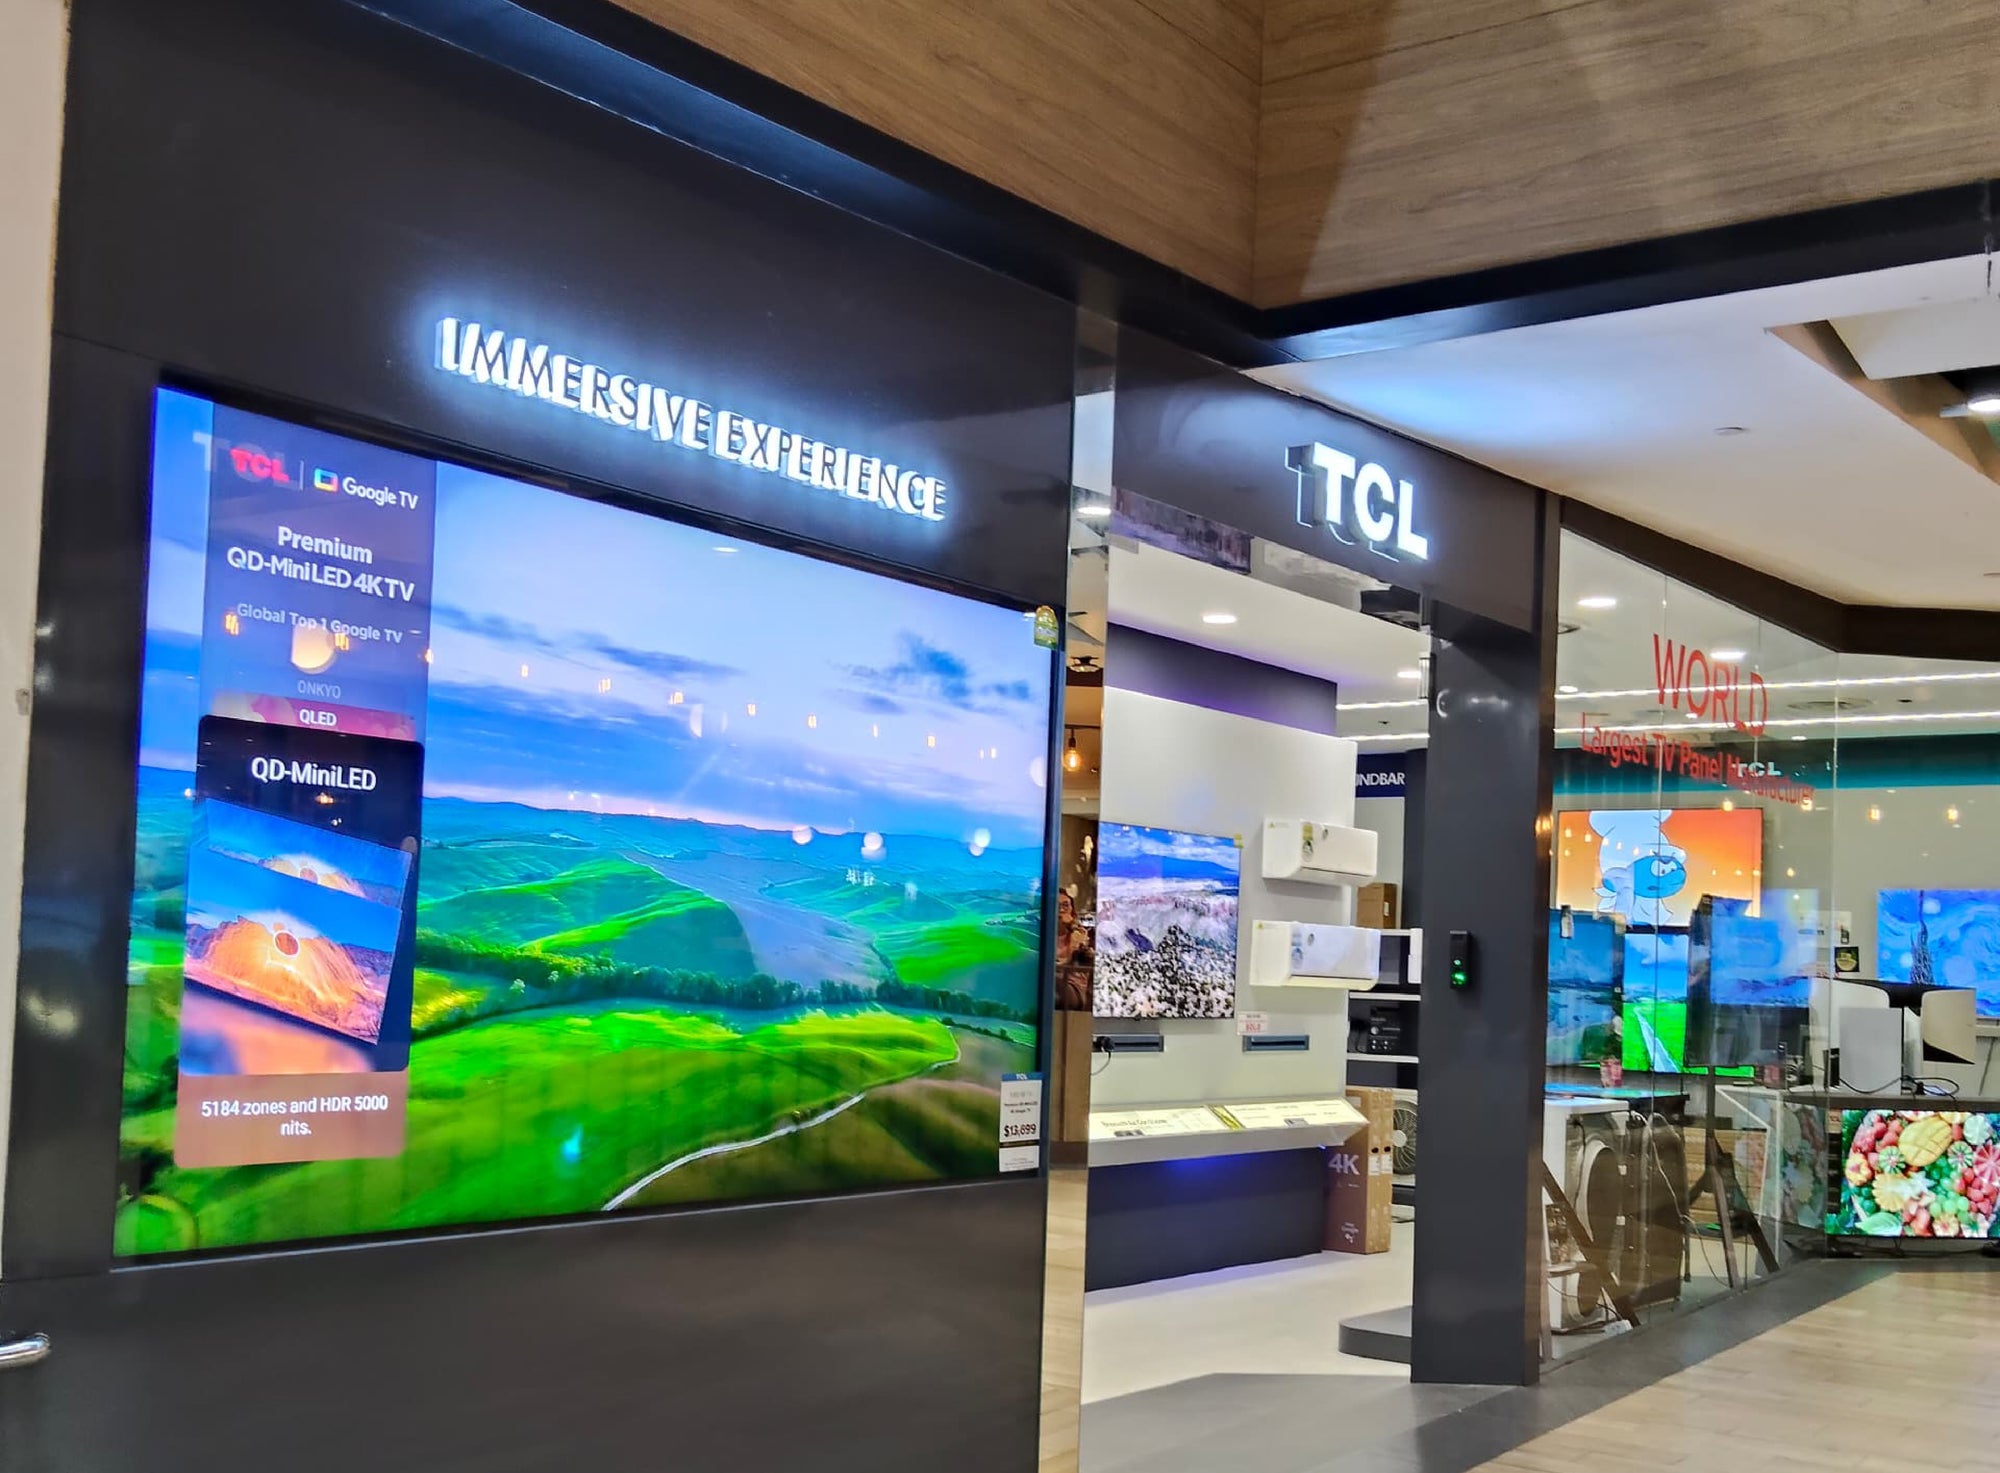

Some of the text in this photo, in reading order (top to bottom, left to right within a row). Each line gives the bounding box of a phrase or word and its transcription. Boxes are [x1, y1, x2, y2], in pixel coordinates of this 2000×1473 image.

[436, 317, 947, 521] IMMERSIVE EXPERIENCE
[230, 447, 418, 510] TCL Google TV
[1311, 441, 1428, 561] TCL
[277, 526, 374, 564] Premium
[354, 570, 384, 597] 4K
[384, 579, 415, 602] TV
[236, 602, 285, 624] Global
[288, 611, 319, 630] Top
[330, 619, 381, 642] Google
[384, 629, 403, 644] TV
[297, 680, 341, 699] ONKYO
[1653, 633, 1767, 737] WORLD
[299, 709, 337, 727] QLED
[1581, 712, 1648, 768] Largest
[1652, 733, 1677, 772] TV
[1679, 739, 1723, 782] Panel
[251, 756, 377, 792] QD-MiniLED
[1732, 762, 1782, 777] TCL
[201, 1094, 389, 1117] 5184 zones and HDR 5000
[280, 1120, 312, 1136] nits.
[1328, 1153, 1360, 1175] 4K
